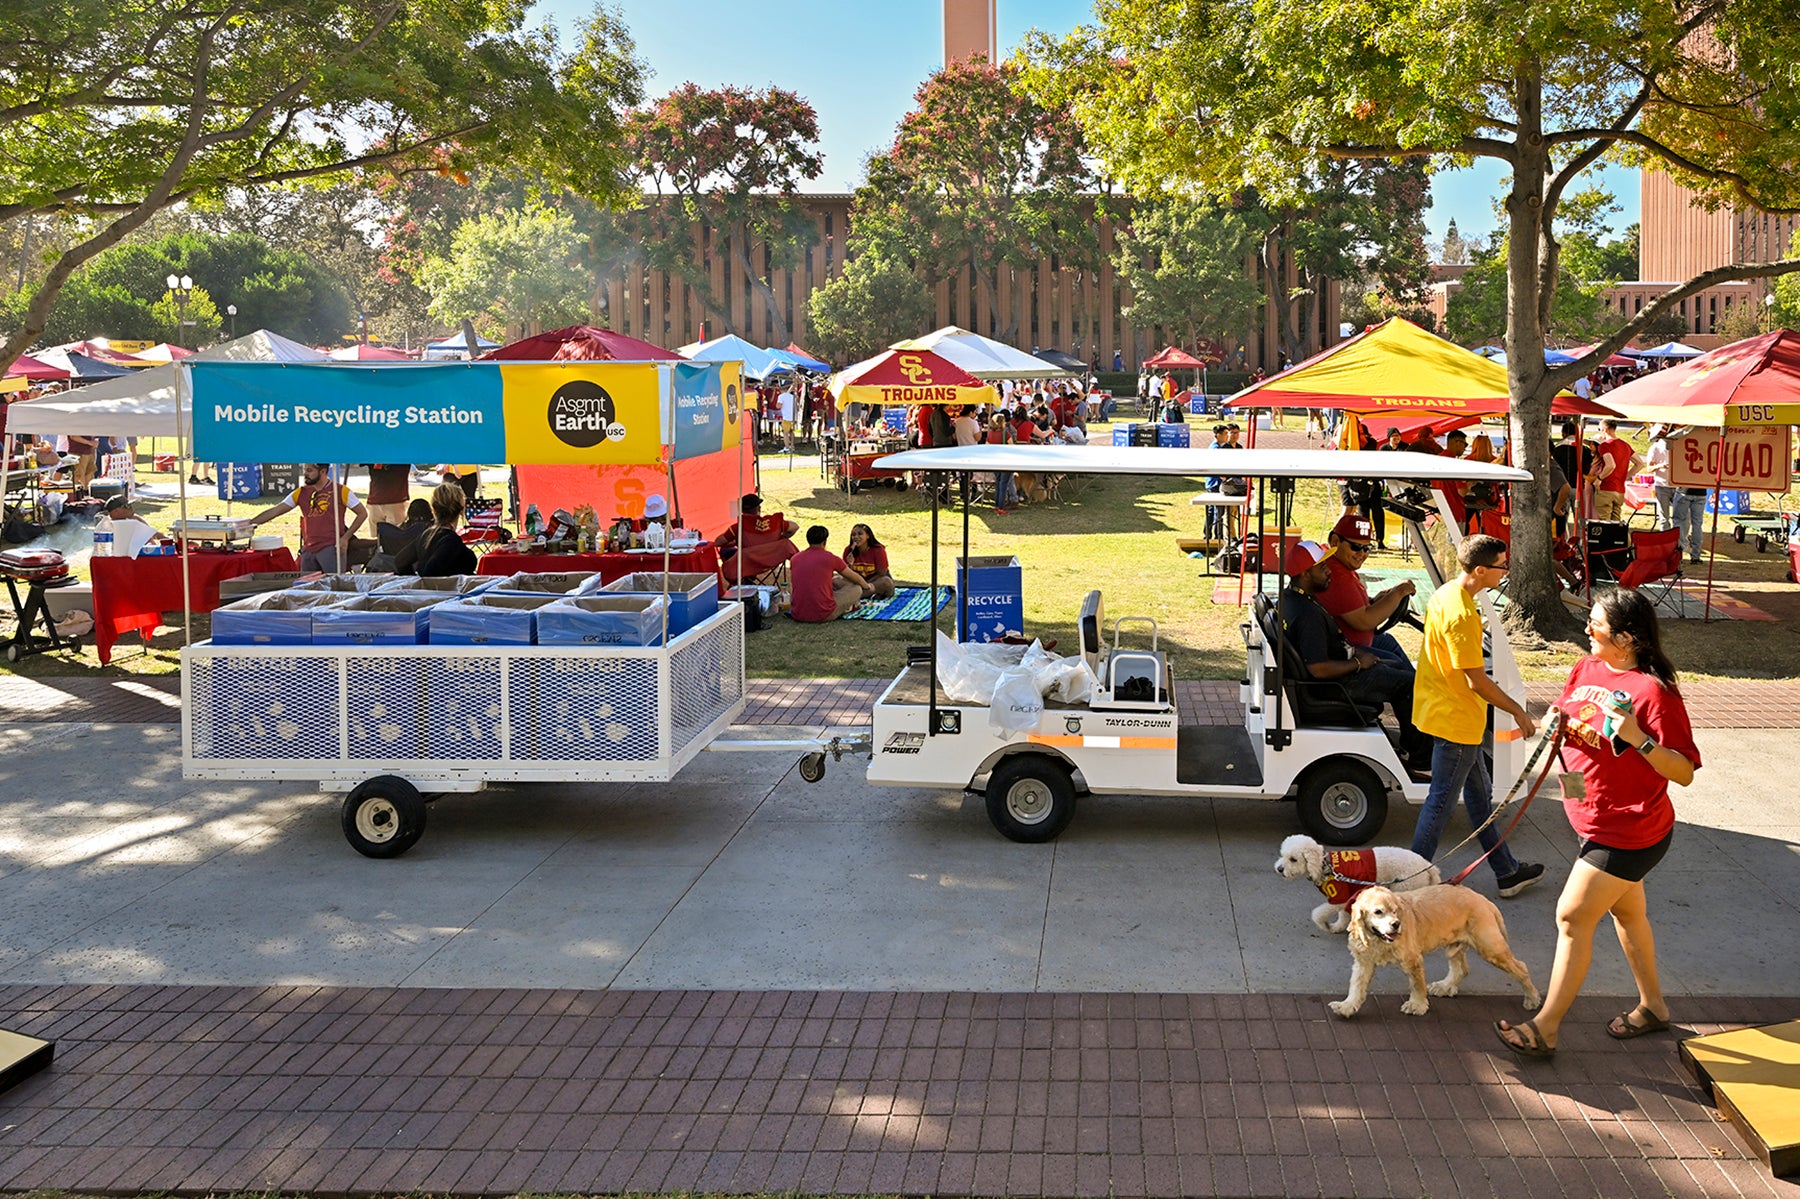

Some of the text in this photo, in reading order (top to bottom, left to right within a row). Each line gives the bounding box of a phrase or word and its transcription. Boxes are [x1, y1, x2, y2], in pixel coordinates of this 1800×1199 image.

[899, 355, 932, 385] SC
[677, 393, 719, 409] Mobile Recycling
[881, 388, 957, 401] TROJANS
[555, 396, 606, 417] Asgmt
[1371, 397, 1467, 408] TROJANS
[214, 404, 483, 428] Mobile Recycling Station
[1738, 404, 1775, 422] USC
[555, 413, 607, 431] Earth
[607, 428, 625, 436] USC
[967, 595, 1012, 606] RECYCLE
[1105, 718, 1171, 728] TAYLOR-DUNN
[884, 732, 926, 747] AC
[882, 746, 920, 755] POWER
